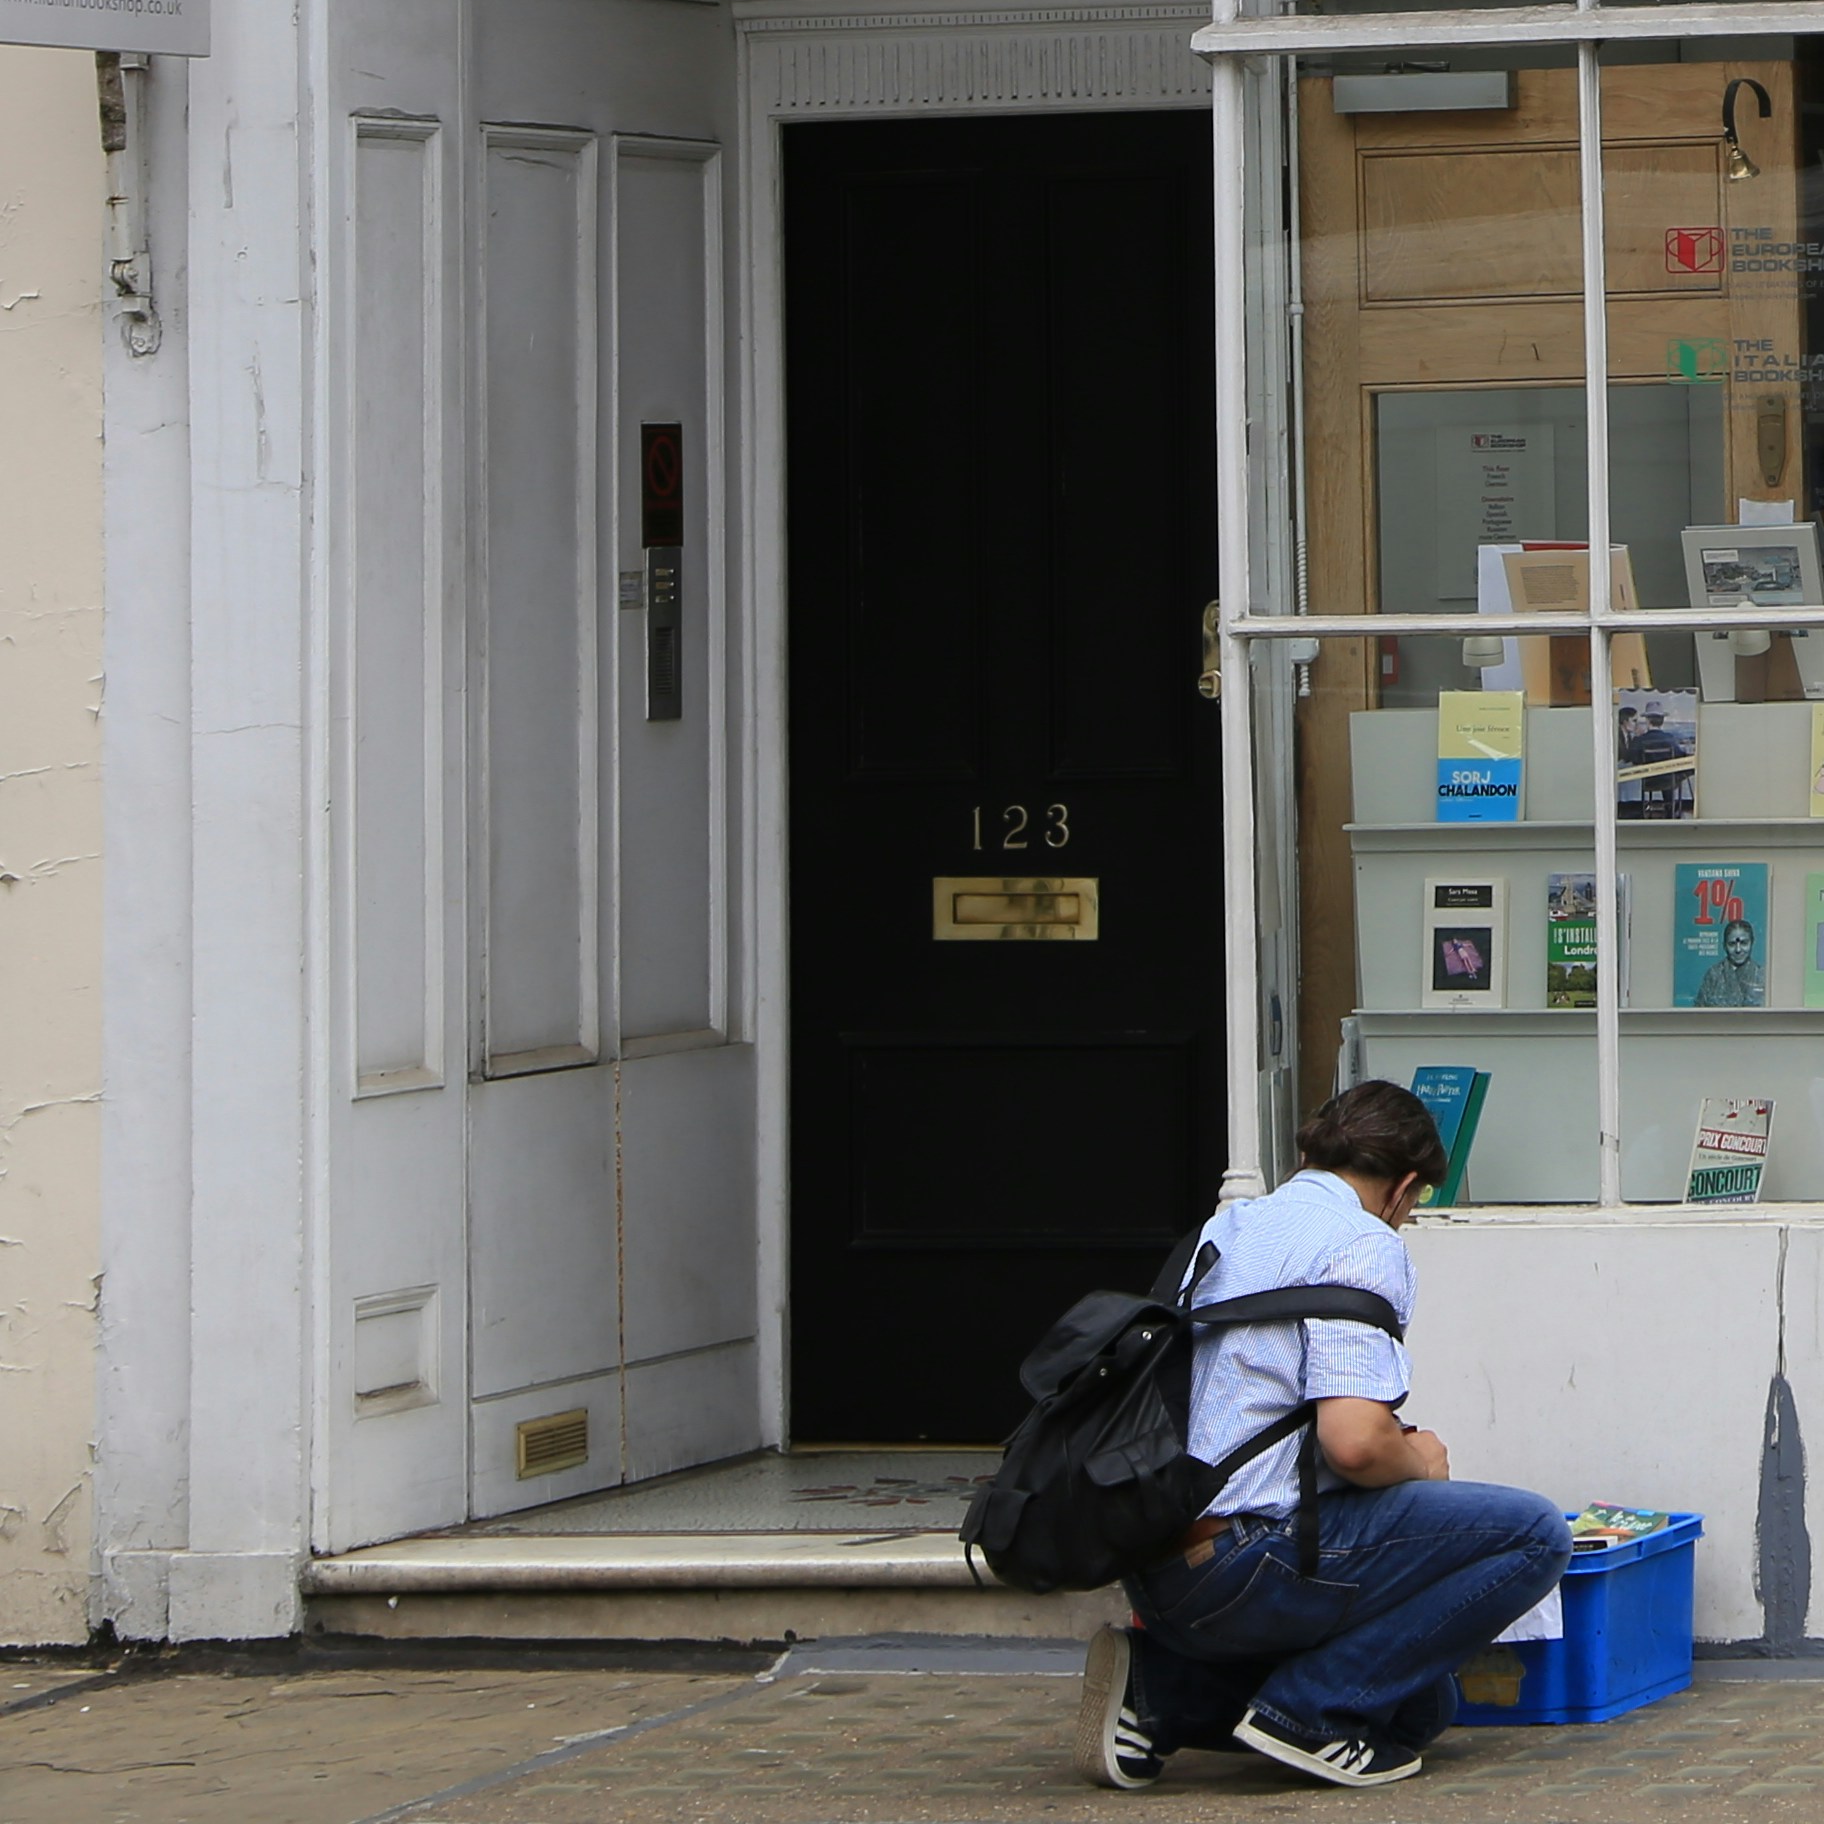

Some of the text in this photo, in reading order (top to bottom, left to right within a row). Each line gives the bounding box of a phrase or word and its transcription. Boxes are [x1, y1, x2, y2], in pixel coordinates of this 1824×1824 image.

[1731, 228, 1772, 240] THE
[1733, 340, 1774, 352] THE
[1451, 770, 1491, 784] SORJ
[1438, 784, 1517, 797] CHALANDON
[973, 803, 1069, 850] 123
[1693, 879, 1744, 925] 1%
[1558, 927, 1597, 944] S'INSTALL
[1564, 945, 1598, 955] Londr
[1698, 1131, 1767, 1154] PRIX GONCOURT
